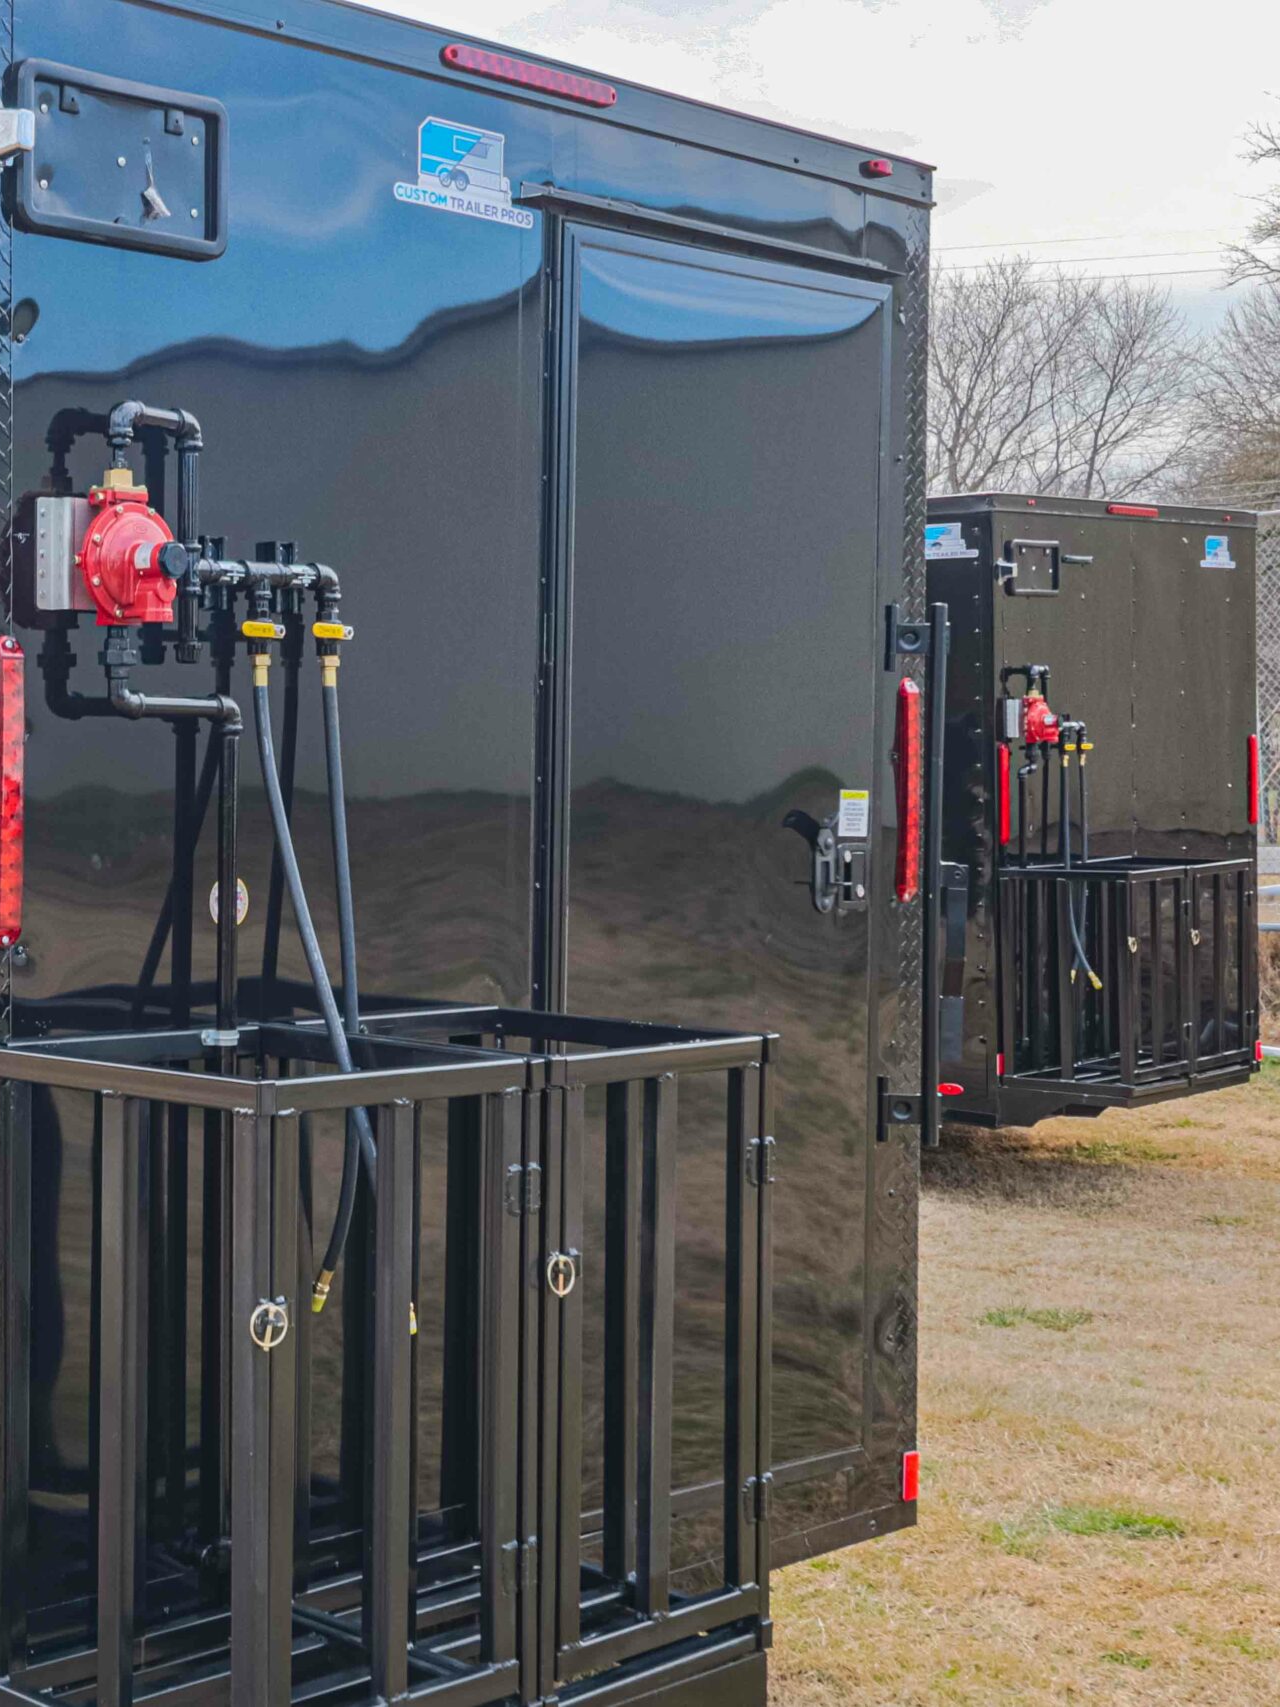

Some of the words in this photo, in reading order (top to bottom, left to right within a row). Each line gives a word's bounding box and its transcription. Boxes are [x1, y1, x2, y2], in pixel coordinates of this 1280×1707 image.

[395, 184, 448, 205] CUSTOM
[450, 196, 499, 219] TRAILER
[501, 209, 532, 227] PROS
